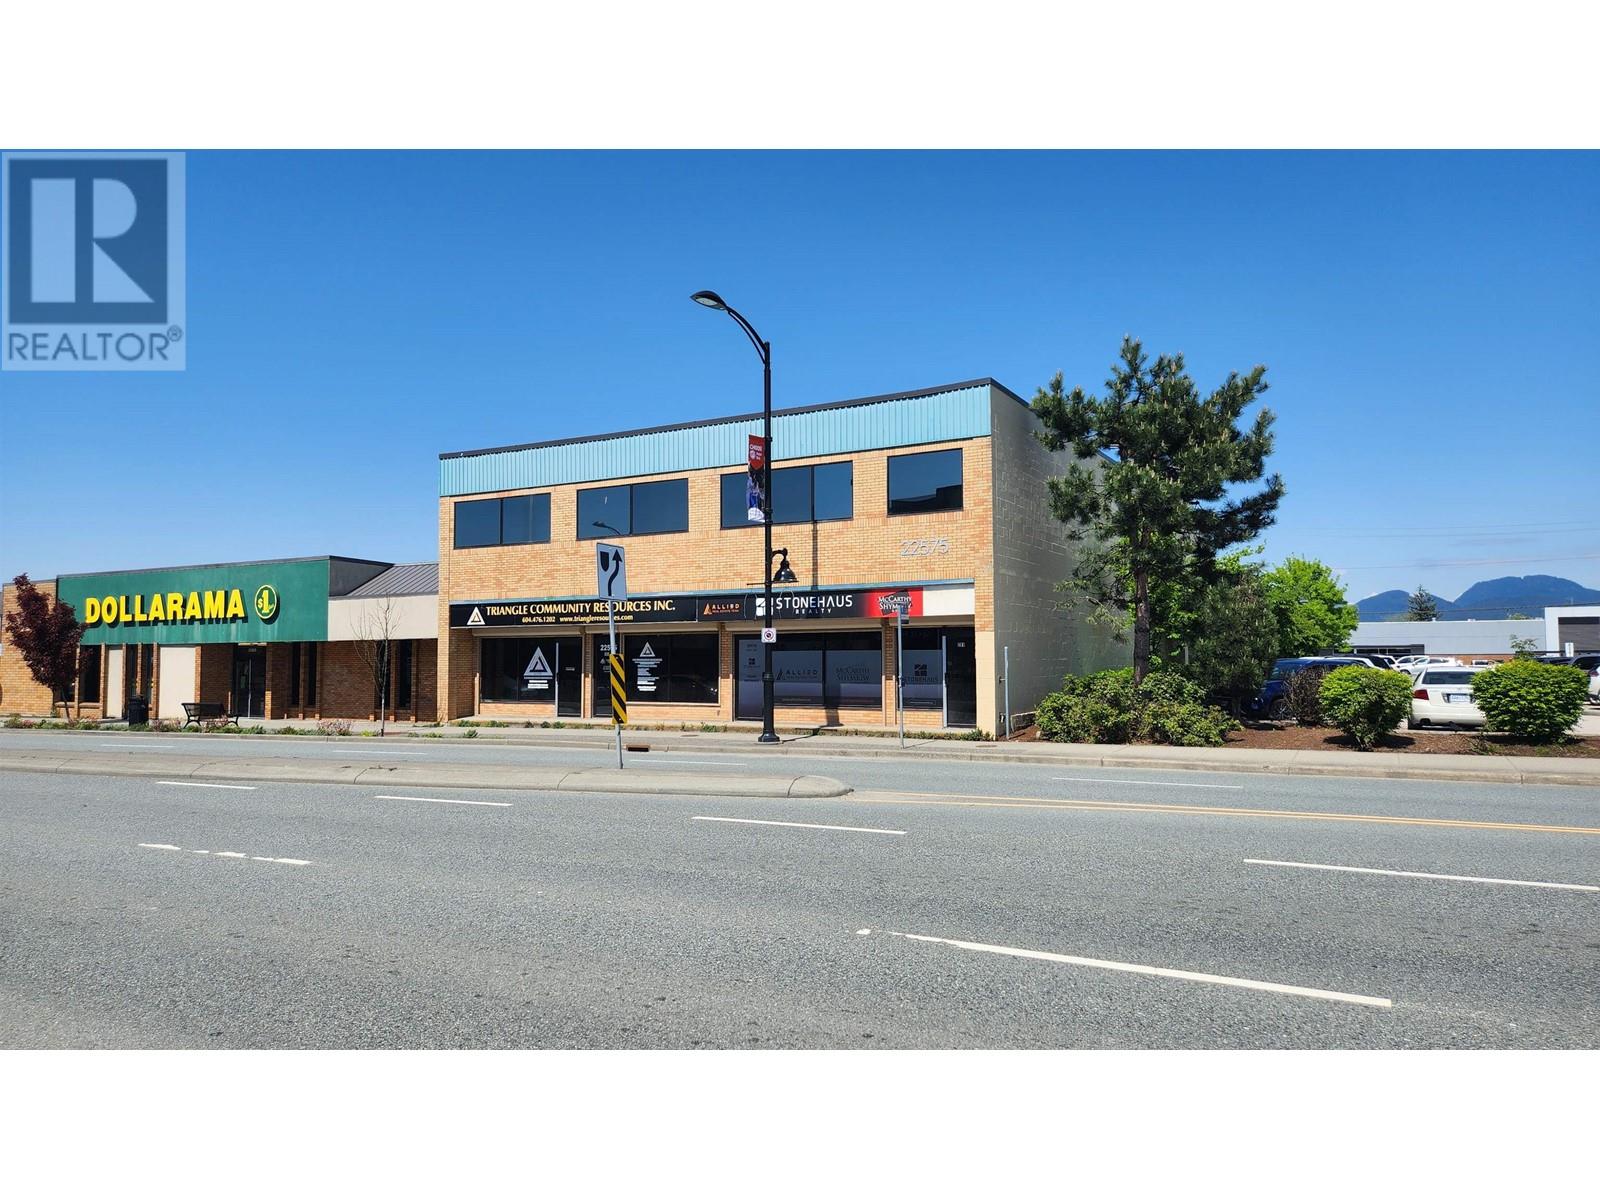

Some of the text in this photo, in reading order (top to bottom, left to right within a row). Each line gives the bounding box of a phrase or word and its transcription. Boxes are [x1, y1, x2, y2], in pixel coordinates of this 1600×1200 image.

[900, 539, 949, 556] 22575
[85, 589, 245, 624] DOLLARAMA
[486, 605, 528, 616] TRIANGLE
[530, 603, 591, 614] COMMUNITY
[654, 600, 676, 611] INC.
[776, 595, 853, 609] STONEHAUS
[559, 614, 634, 623] www.triangleresoues.com
